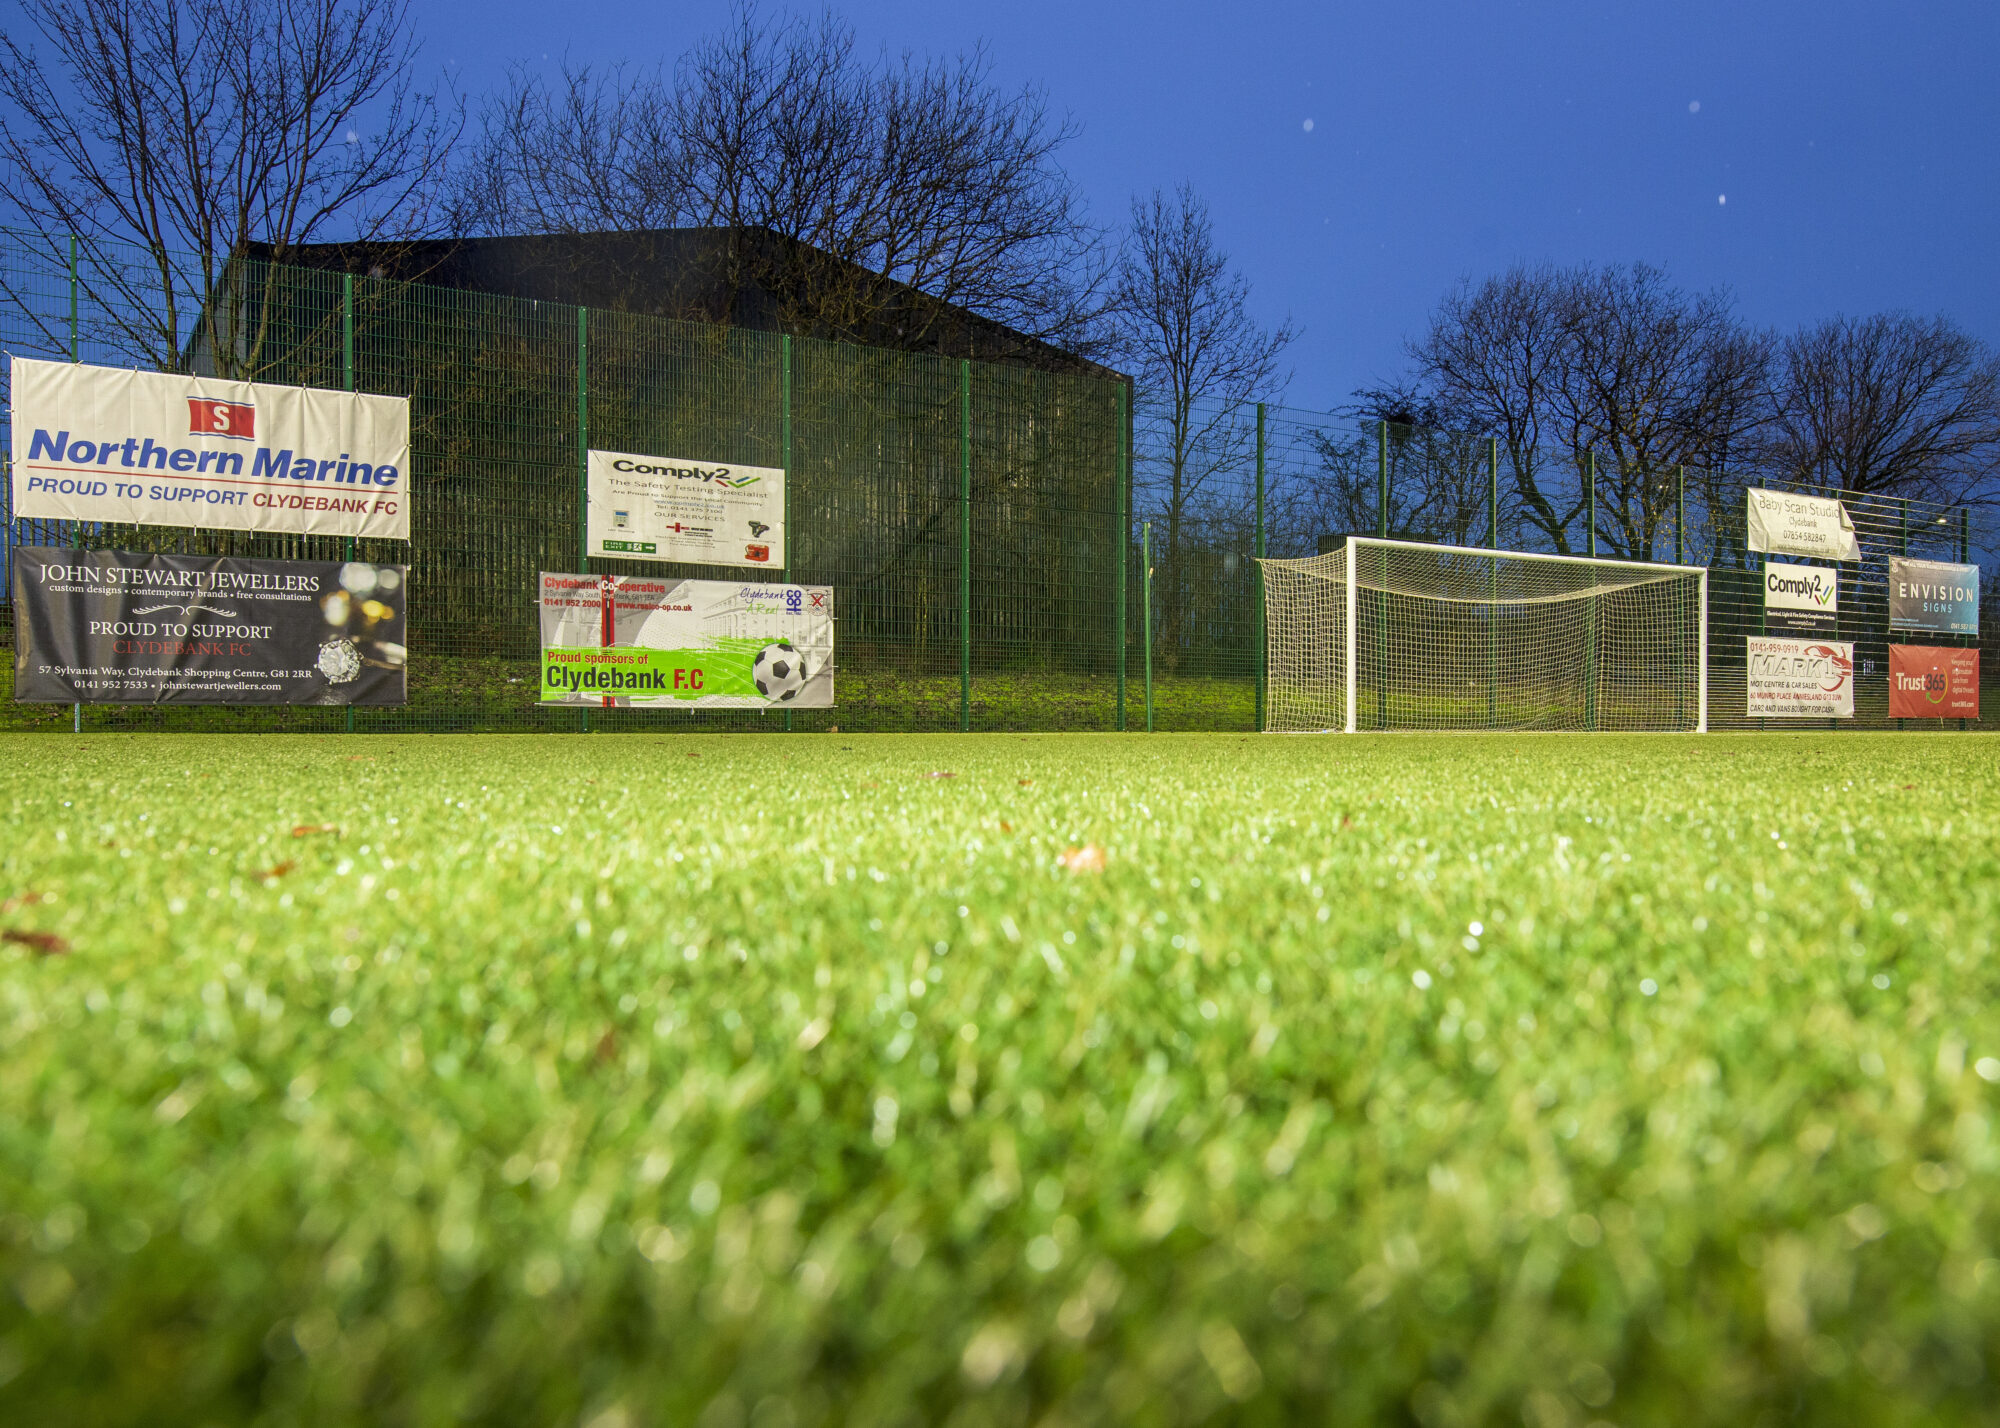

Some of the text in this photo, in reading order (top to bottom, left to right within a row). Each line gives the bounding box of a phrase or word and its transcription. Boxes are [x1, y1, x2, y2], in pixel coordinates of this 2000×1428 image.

[213, 405, 230, 431] S
[28, 429, 398, 486] Northern Marine
[613, 459, 731, 482] Comply2
[27, 477, 397, 515] PROUD TO SUPPORT CLYDEBANK FC
[608, 478, 769, 499] The Safety Testing Specialist
[724, 499, 764, 507] Community
[1760, 495, 1840, 518] Baby Scan Studio
[654, 511, 726, 522] OUR SERVICES
[1789, 516, 1818, 529] Clydebank
[40, 564, 320, 592] JOHN STEWART JEWELLERS
[544, 577, 666, 593] Clydebank Co-operative
[1767, 573, 1821, 599] Comply2
[49, 584, 312, 601] custom designs contemporary brands free consultations
[740, 587, 785, 604] Clydebank
[1899, 582, 1973, 603] ENVISION
[544, 597, 563, 606] 0141
[565, 599, 580, 607] 952
[582, 600, 601, 608] 2000
[1923, 602, 1953, 614] SIGNS
[89, 620, 272, 639] PROUD TO SUPPORT
[113, 640, 252, 656] CLYDEBANK FC
[1750, 642, 1799, 654] 0141-959-0919
[547, 651, 648, 665] Proud sponsors of
[39, 665, 312, 679] 57 Sylvania Way, Clydebank Shopping Centre, G81 2RR
[547, 665, 704, 692] Clydebank F.C
[74, 680, 282, 693] 0141 952 7533 johnstewartjewellers.com
[1750, 680, 1763, 688] MOT
[1896, 672, 1945, 691] Trust365
[1777, 692, 1791, 700] PLACE
[1765, 705, 1776, 713] AND
[1777, 705, 1791, 713] VANS
[1791, 706, 1811, 714] BOUGHT
[1811, 706, 1822, 714] FOR
[1821, 706, 1835, 714] CASH
